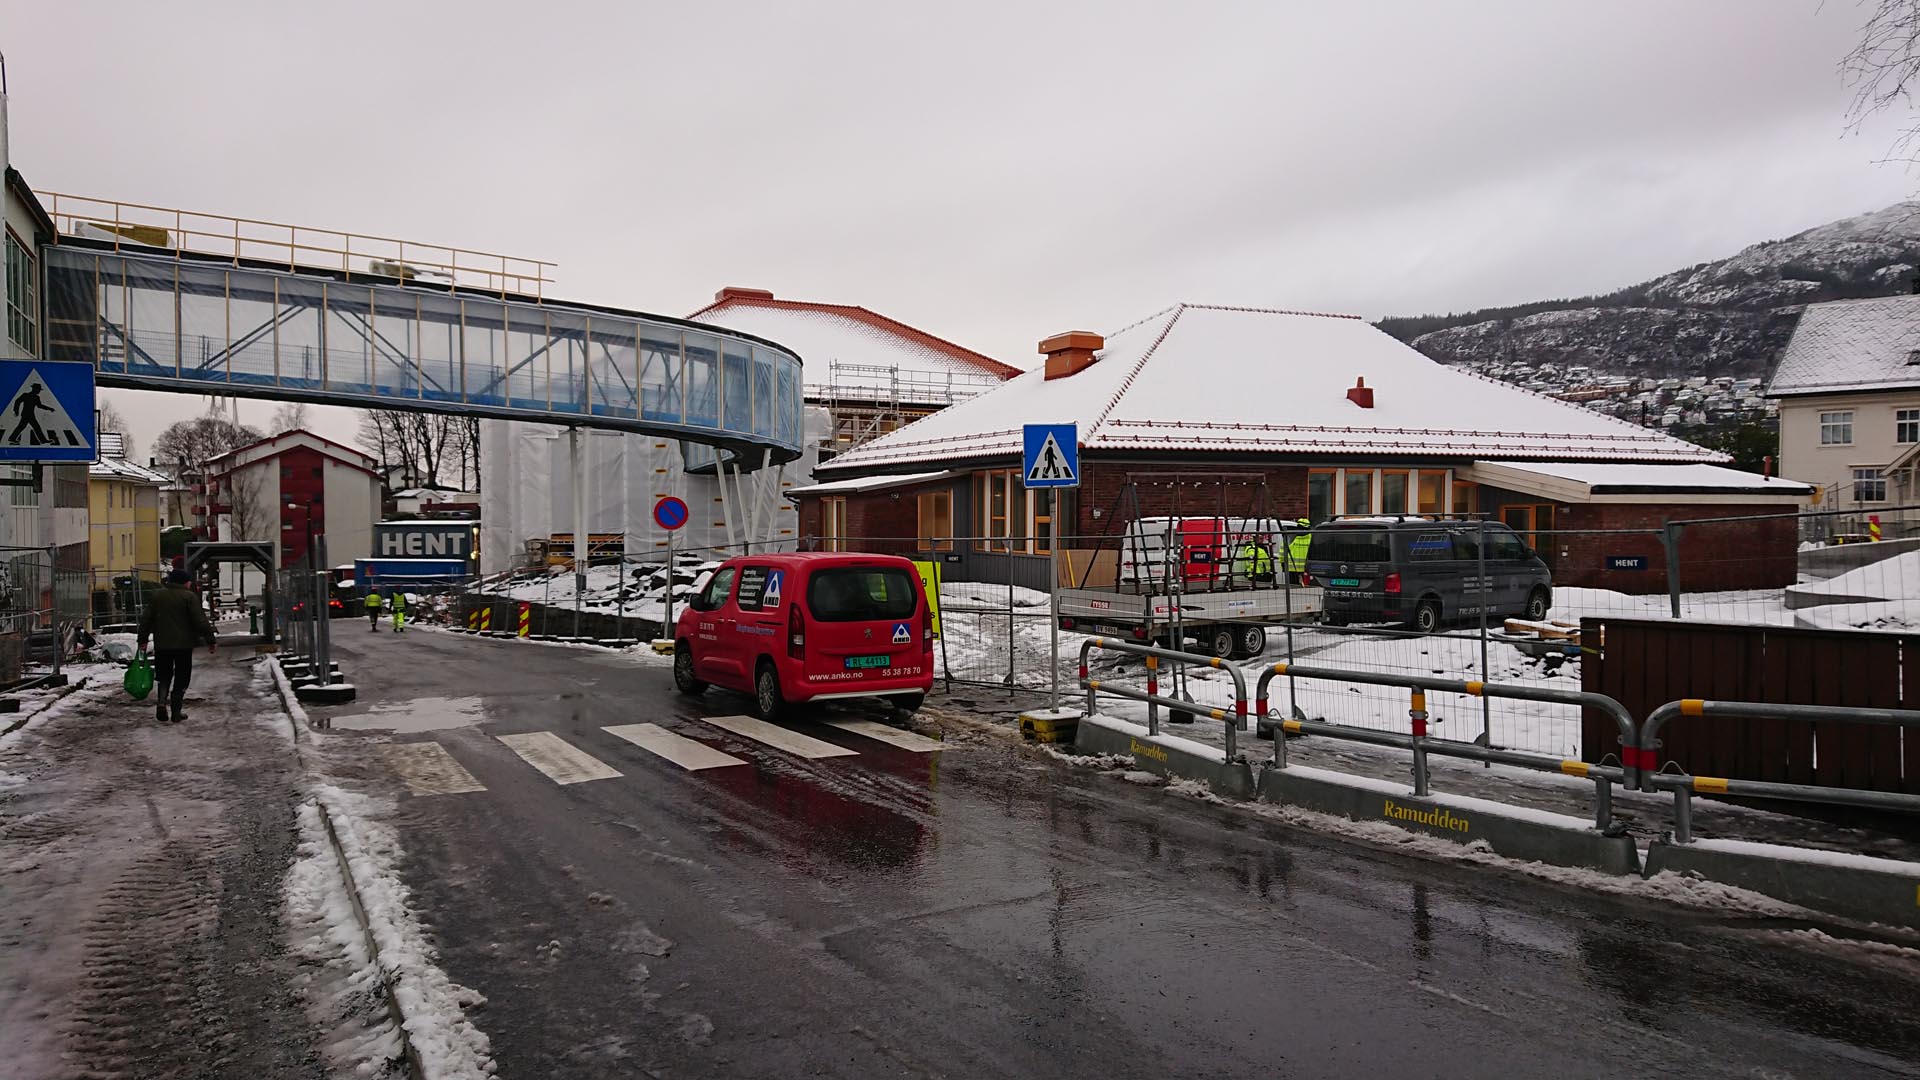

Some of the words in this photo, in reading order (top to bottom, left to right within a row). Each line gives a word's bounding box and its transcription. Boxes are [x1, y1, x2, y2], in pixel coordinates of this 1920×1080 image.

[382, 533, 465, 555] HENT
[1615, 559, 1639, 567] HENT
[763, 596, 779, 606] ANKO
[852, 658, 862, 667] RL
[808, 671, 864, 681] www.anko.no
[882, 669, 891, 677] 55
[892, 668, 901, 676] 38
[903, 667, 911, 675] 78
[912, 666, 921, 674] 70
[1384, 800, 1469, 832] Ramudden
